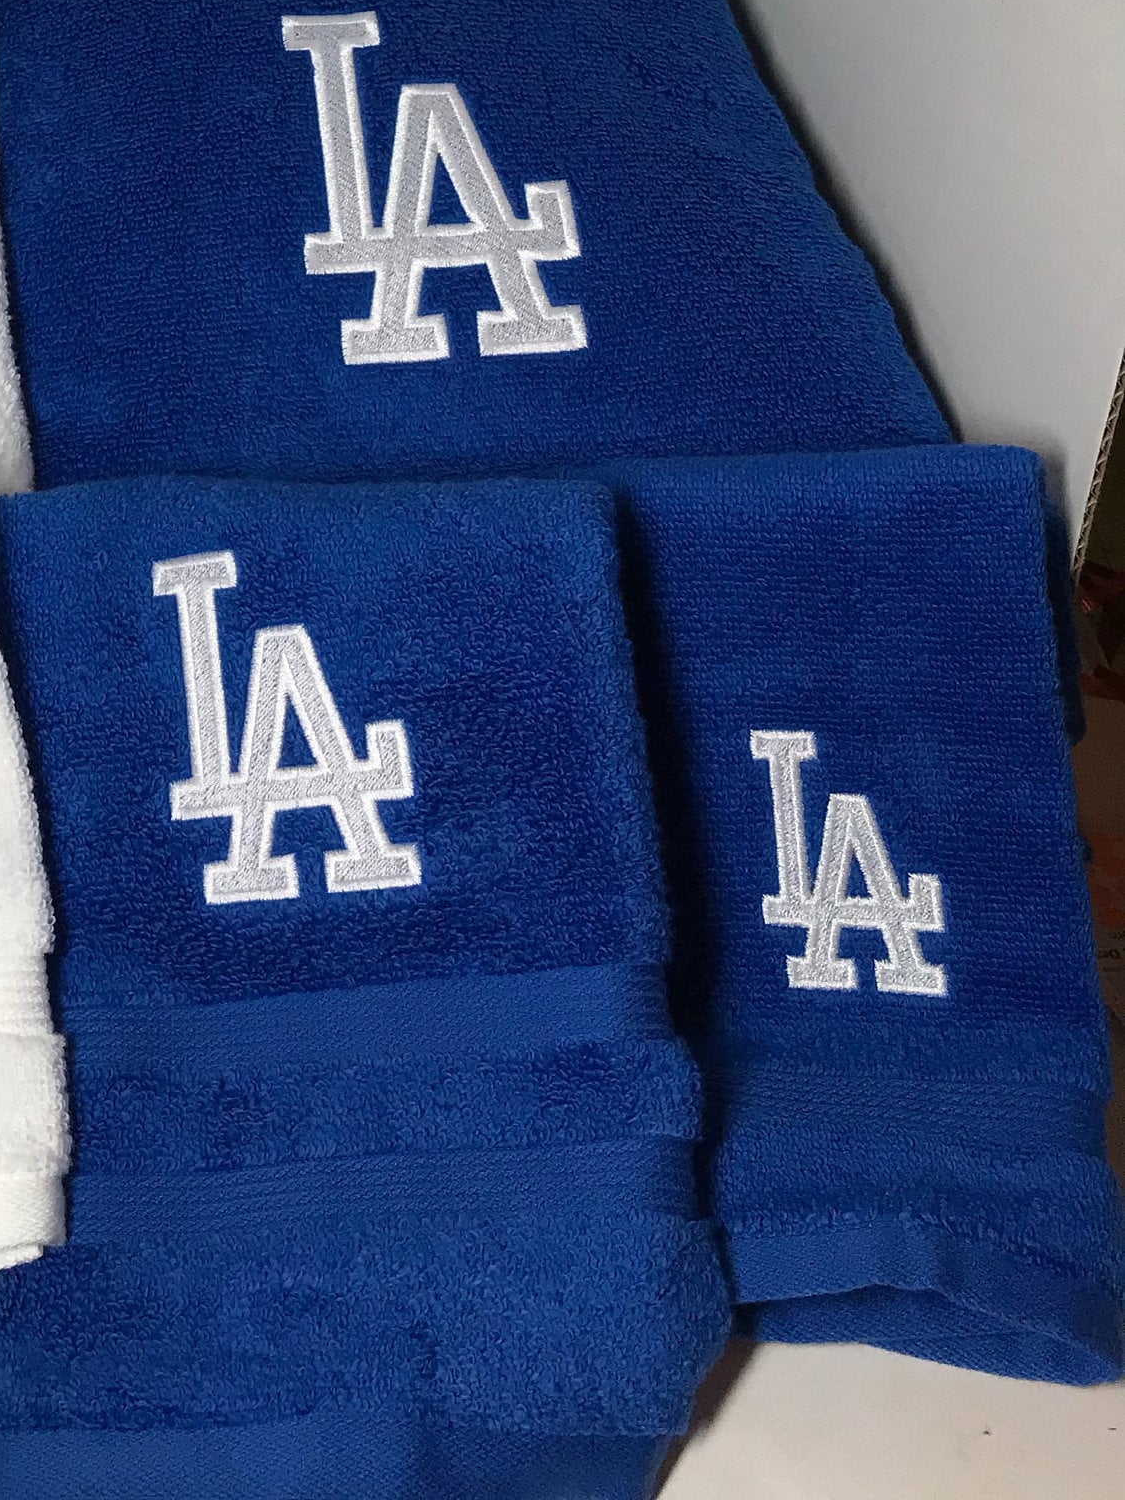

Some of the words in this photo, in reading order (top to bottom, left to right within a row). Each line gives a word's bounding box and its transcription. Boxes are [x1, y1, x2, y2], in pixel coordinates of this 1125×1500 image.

[283, 12, 587, 364] LA
[154, 552, 422, 903] LA
[751, 731, 946, 994] LA
